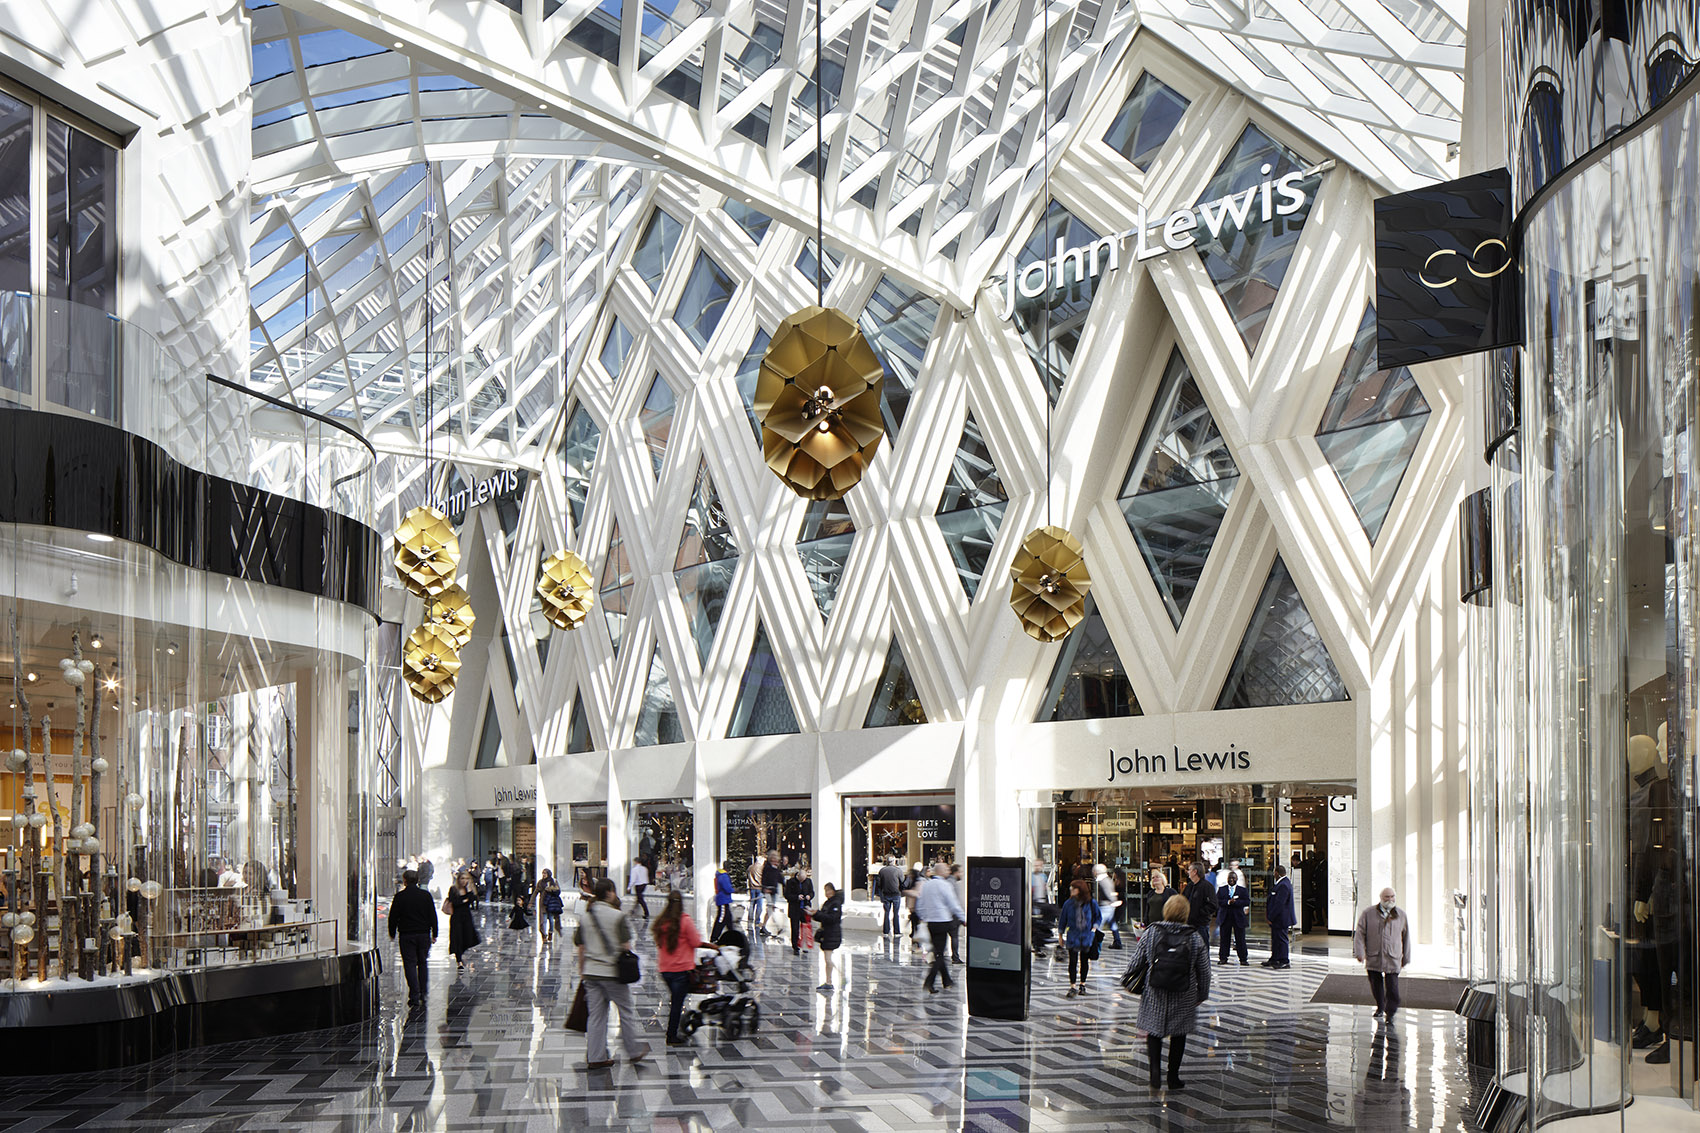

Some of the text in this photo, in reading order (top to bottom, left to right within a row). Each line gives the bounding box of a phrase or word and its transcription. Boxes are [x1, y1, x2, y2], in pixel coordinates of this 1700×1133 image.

[997, 163, 1306, 322] John Lewis
[1419, 238, 1512, 288] CO
[470, 469, 519, 508] Lewis
[1108, 743, 1251, 782] John Lewis
[494, 784, 537, 806] John Lewis
[1330, 796, 1346, 812] G
[977, 908, 1002, 916] REGULAR
[981, 915, 999, 923] WON'T
